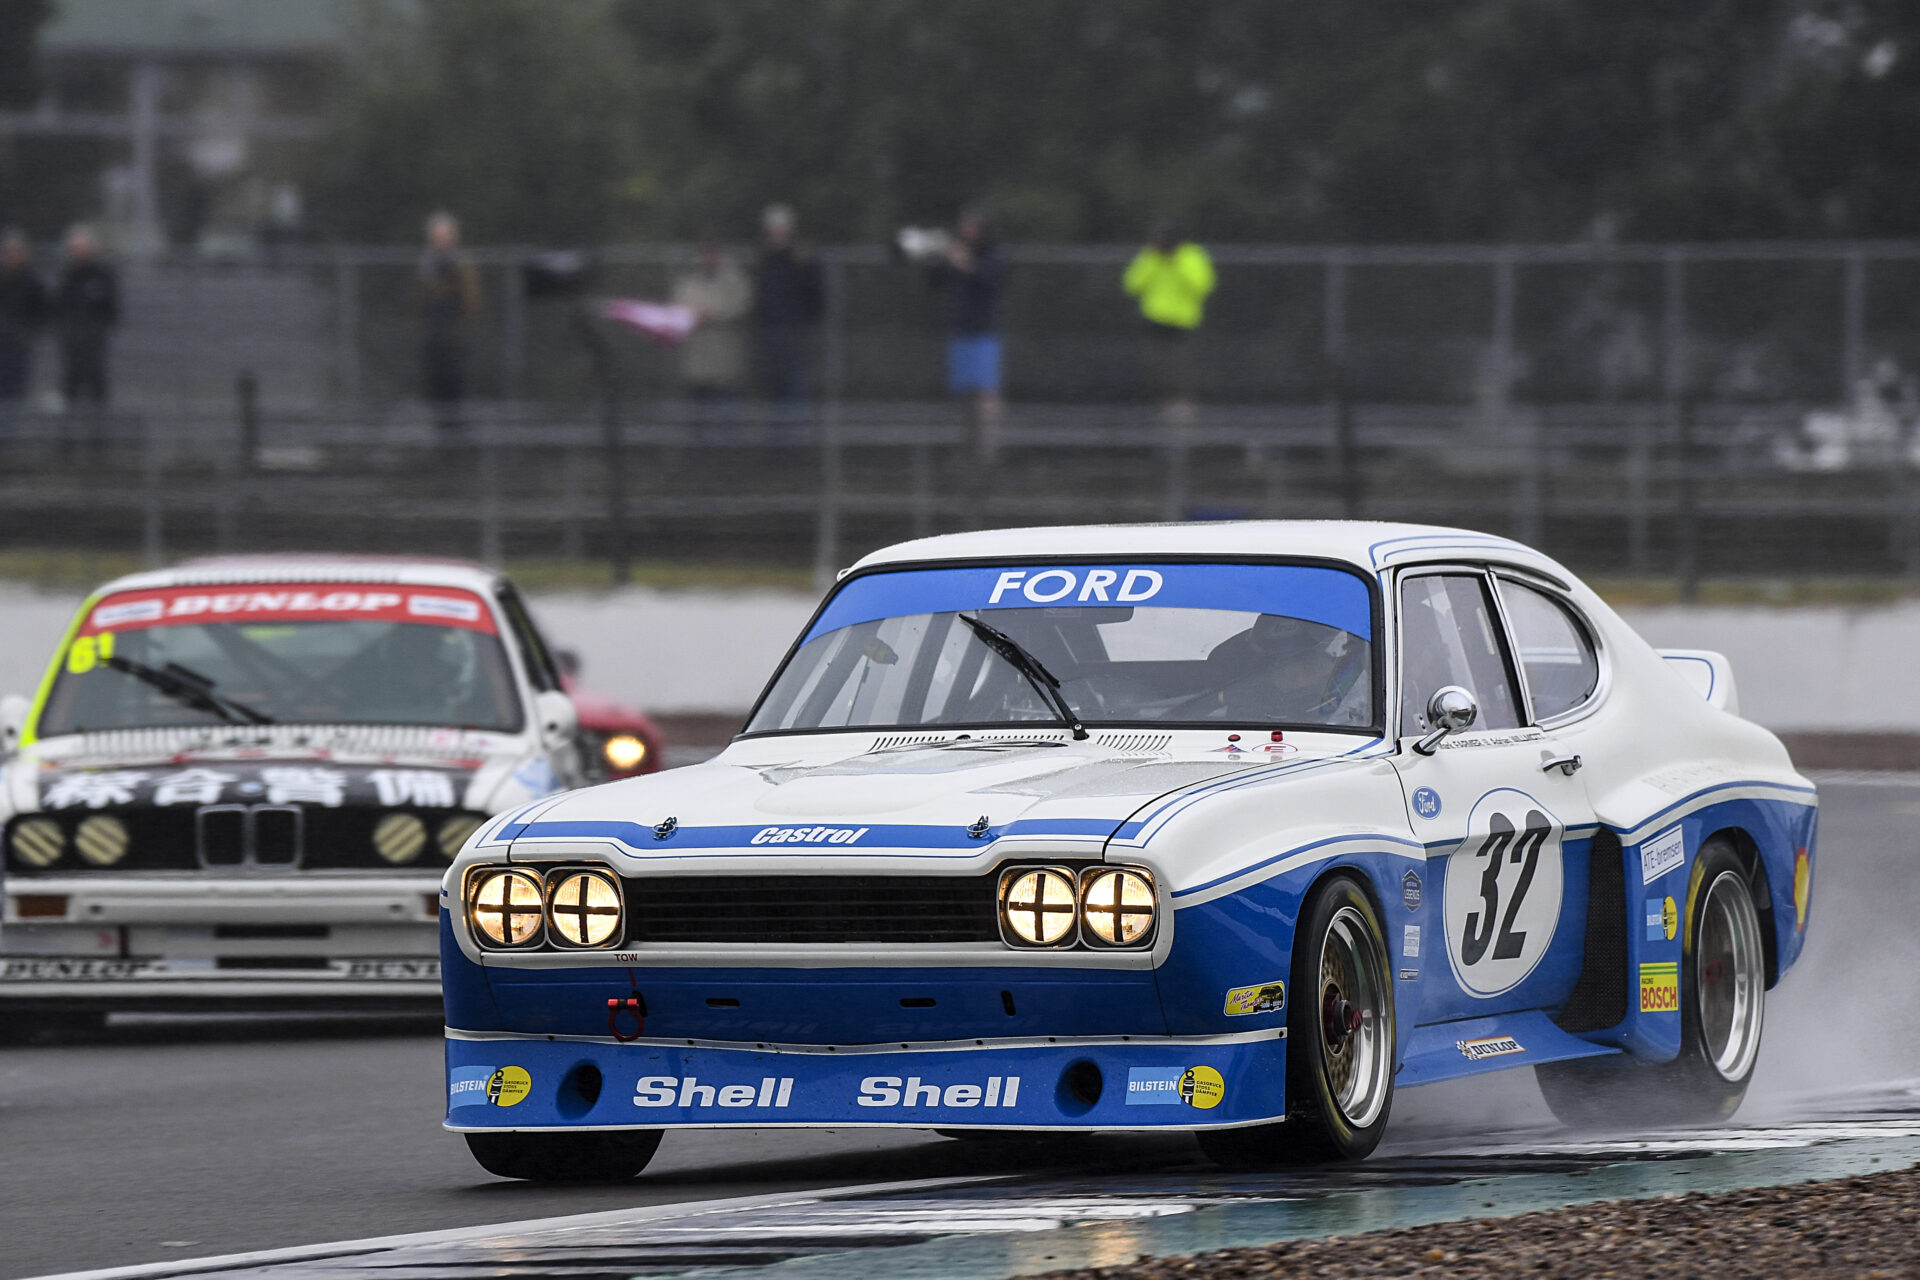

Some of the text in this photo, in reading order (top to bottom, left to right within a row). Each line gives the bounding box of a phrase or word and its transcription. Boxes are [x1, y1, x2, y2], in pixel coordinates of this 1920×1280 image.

[988, 569, 1163, 604] FORD
[167, 591, 404, 616] DUNLOP
[1418, 791, 1437, 814] Ford
[750, 826, 870, 845] Castrol
[1461, 809, 1552, 966] 32
[614, 953, 638, 962] TOW
[1, 961, 150, 978] DUNLOP
[349, 961, 442, 979] DUNL
[1641, 986, 1678, 1009] BOSCH
[1471, 1040, 1518, 1055] DUNLOP
[451, 1080, 486, 1095] BILSTEIN
[633, 1076, 795, 1107] Shell
[857, 1076, 1020, 1107] Shell
[1129, 1081, 1177, 1092] BILSTEIN
